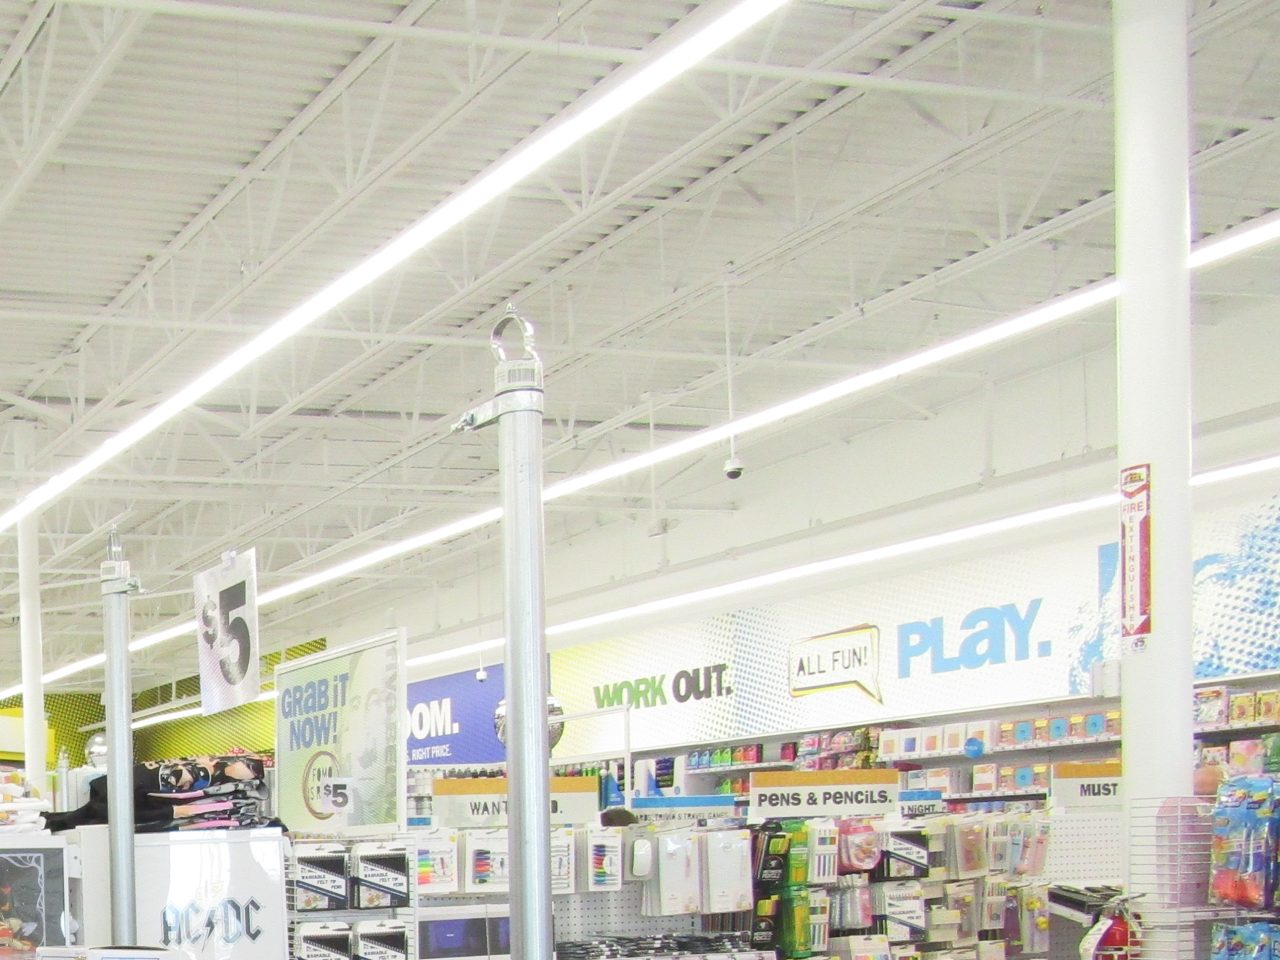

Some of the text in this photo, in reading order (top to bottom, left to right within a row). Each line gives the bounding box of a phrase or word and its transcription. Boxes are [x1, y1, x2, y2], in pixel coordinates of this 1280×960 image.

[1123, 501, 1144, 514] FIRE
[1127, 515, 1136, 632] EXTINGUISHER
[202, 580, 251, 686] $5
[797, 646, 868, 677] ALL FUN!
[593, 663, 734, 709] WORK OUT.
[289, 711, 338, 751] NOW!
[407, 698, 459, 740] OM.
[411, 746, 430, 762] RIGHT
[312, 766, 333, 782] FOMO
[324, 783, 349, 808] $5
[806, 791, 818, 806] &
